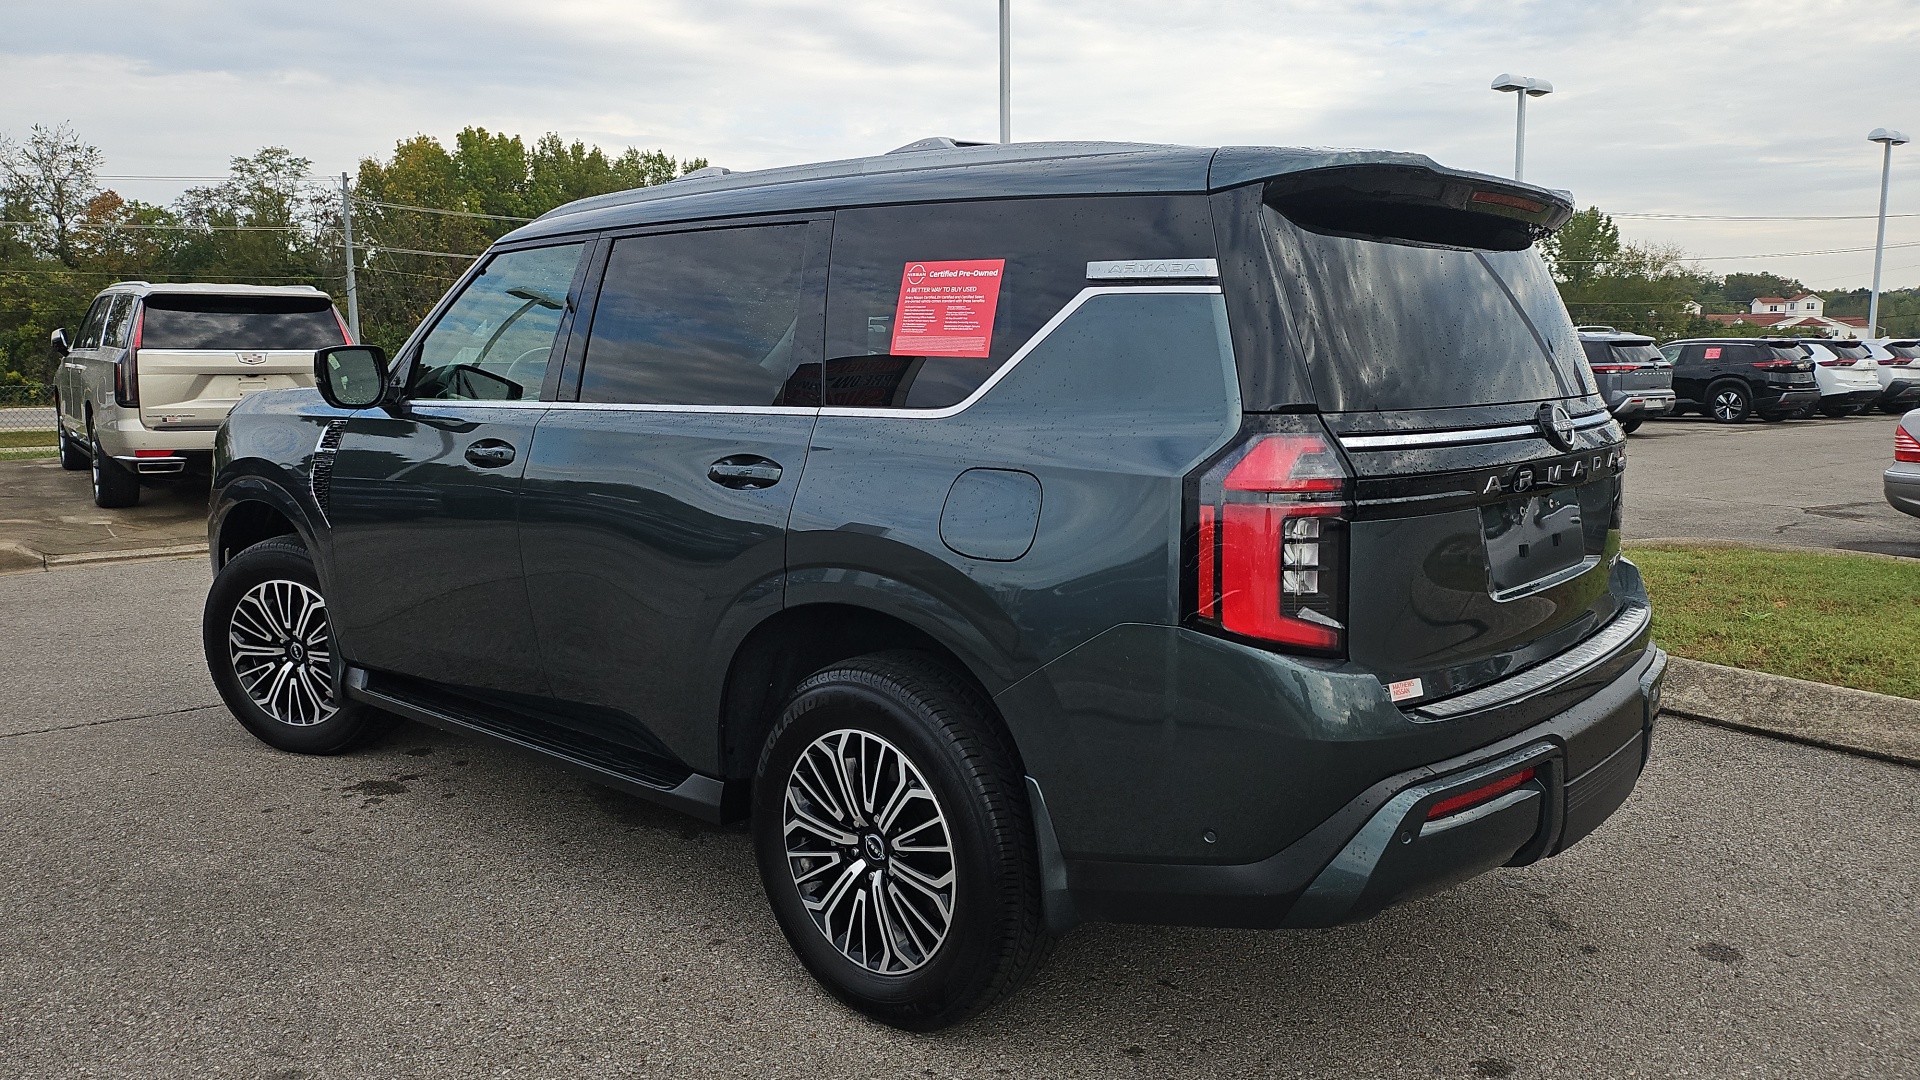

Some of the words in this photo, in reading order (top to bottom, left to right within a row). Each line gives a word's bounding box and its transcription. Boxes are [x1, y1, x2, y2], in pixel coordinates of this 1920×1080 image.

[1108, 263, 1200, 274] ARMADA
[929, 270, 957, 278] Certified
[958, 269, 998, 277] Pre-Owned
[1483, 452, 1617, 495] ARMADA
[1392, 681, 1414, 690] MATHEWS
[1393, 688, 1410, 696] NISSAN
